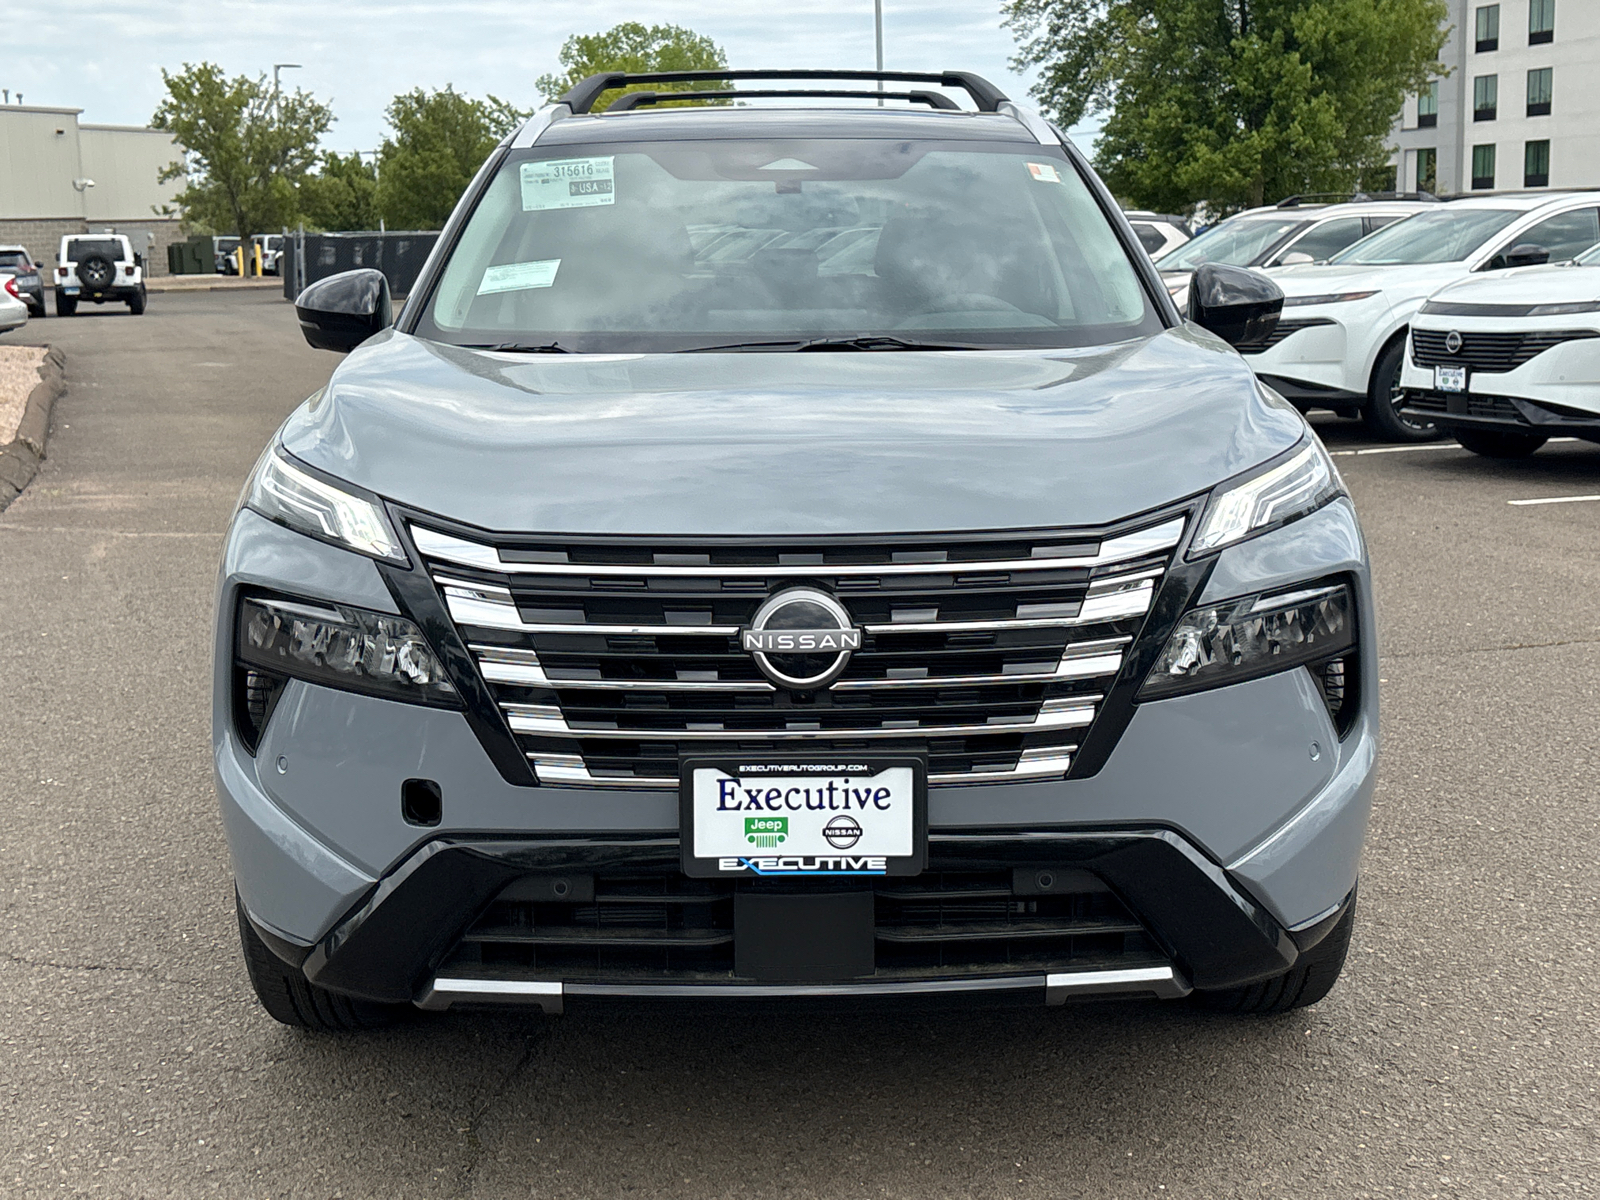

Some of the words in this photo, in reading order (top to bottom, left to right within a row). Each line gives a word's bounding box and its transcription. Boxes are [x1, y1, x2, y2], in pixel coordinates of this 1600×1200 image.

[553, 164, 593, 178] 315616
[579, 182, 598, 193] USA
[746, 633, 858, 649] NISSAN
[716, 778, 891, 811] Executive
[751, 819, 783, 830] Jeep
[719, 857, 887, 870] EXECUTIVE
